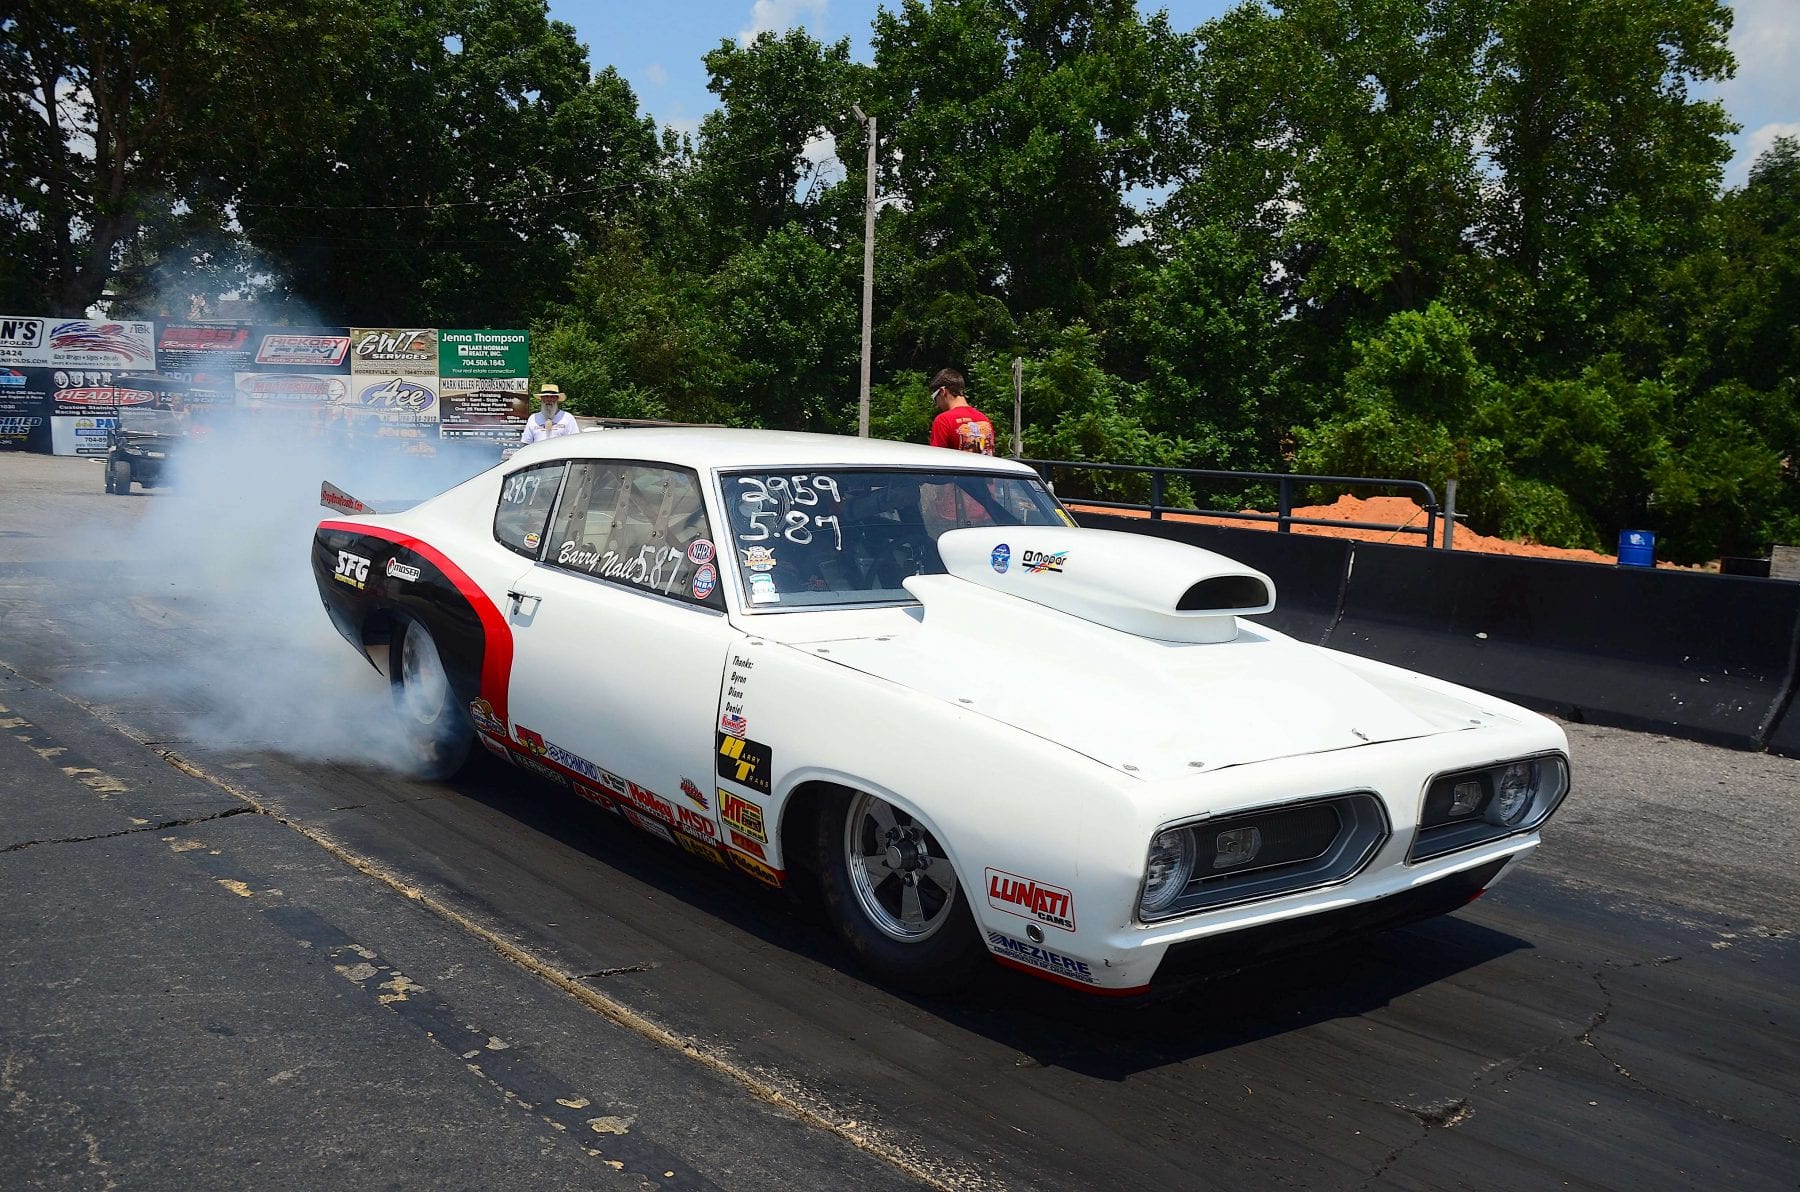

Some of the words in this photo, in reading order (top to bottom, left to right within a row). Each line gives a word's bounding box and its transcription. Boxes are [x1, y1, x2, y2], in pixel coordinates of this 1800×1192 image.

[442, 333, 472, 342] Jenna
[474, 333, 525, 344] Thompson
[59, 391, 150, 400] HEADERS
[367, 378, 426, 406] Ace
[738, 475, 841, 506] 2959
[740, 509, 842, 551] 5.87
[558, 541, 600, 572] Barry
[600, 551, 637, 579] Nall
[693, 543, 712, 560] NHRA
[1033, 551, 1067, 566] Mopar
[335, 550, 371, 582] SFG
[393, 564, 420, 578] MOSER
[632, 544, 684, 596] 5.87
[693, 579, 714, 590] IHRA
[732, 655, 754, 669] Thanks:
[730, 671, 747, 684] Byron
[725, 701, 743, 715] Daniel
[559, 750, 598, 780] RICHMOND
[627, 781, 676, 825] Holley
[677, 804, 715, 837] MSD
[682, 823, 717, 847] IGNITION
[990, 875, 1069, 918] LUNATI
[1037, 911, 1073, 928] CAMS
[1000, 936, 1092, 976] MEZIERE
